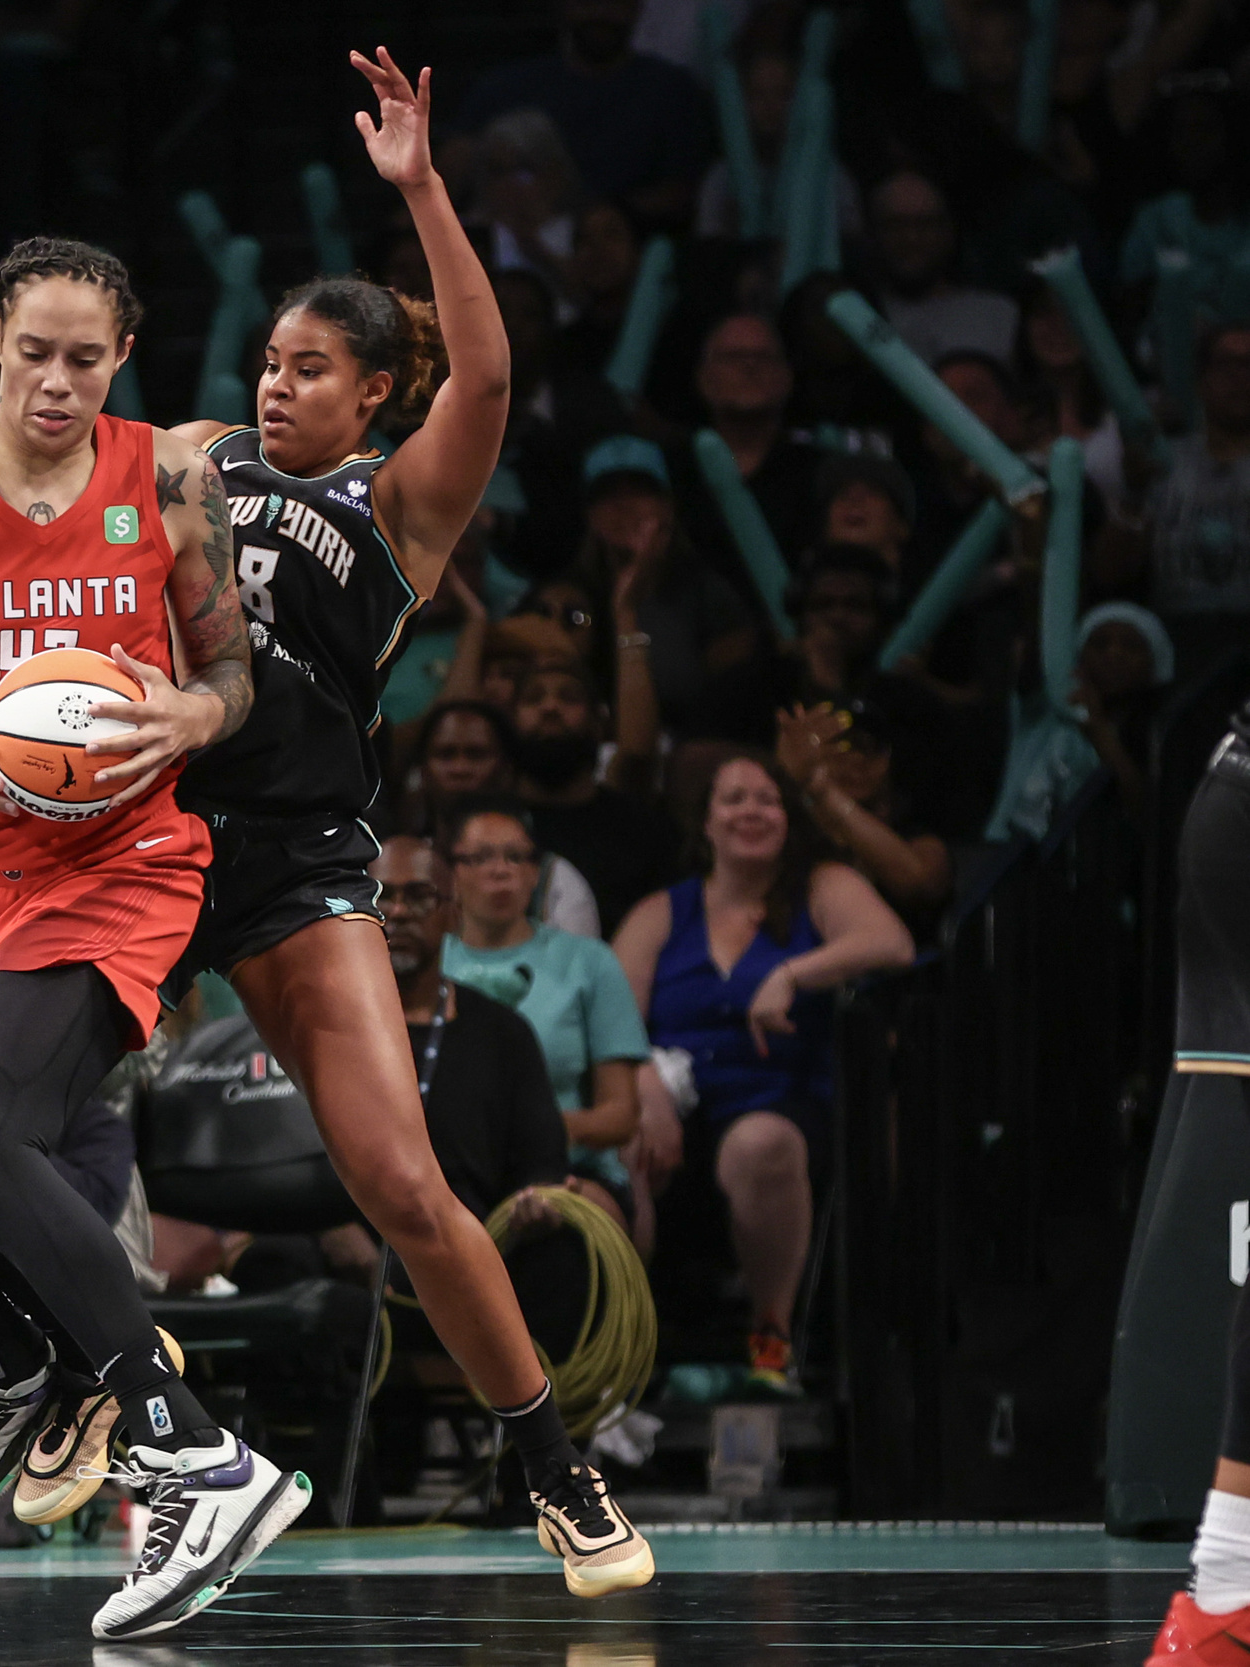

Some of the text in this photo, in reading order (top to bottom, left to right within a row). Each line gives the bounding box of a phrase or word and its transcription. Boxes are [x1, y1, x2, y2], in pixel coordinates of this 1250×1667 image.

[326, 488, 372, 517] BARCLAYS
[237, 543, 281, 624] 8
[277, 498, 357, 589] YORK
